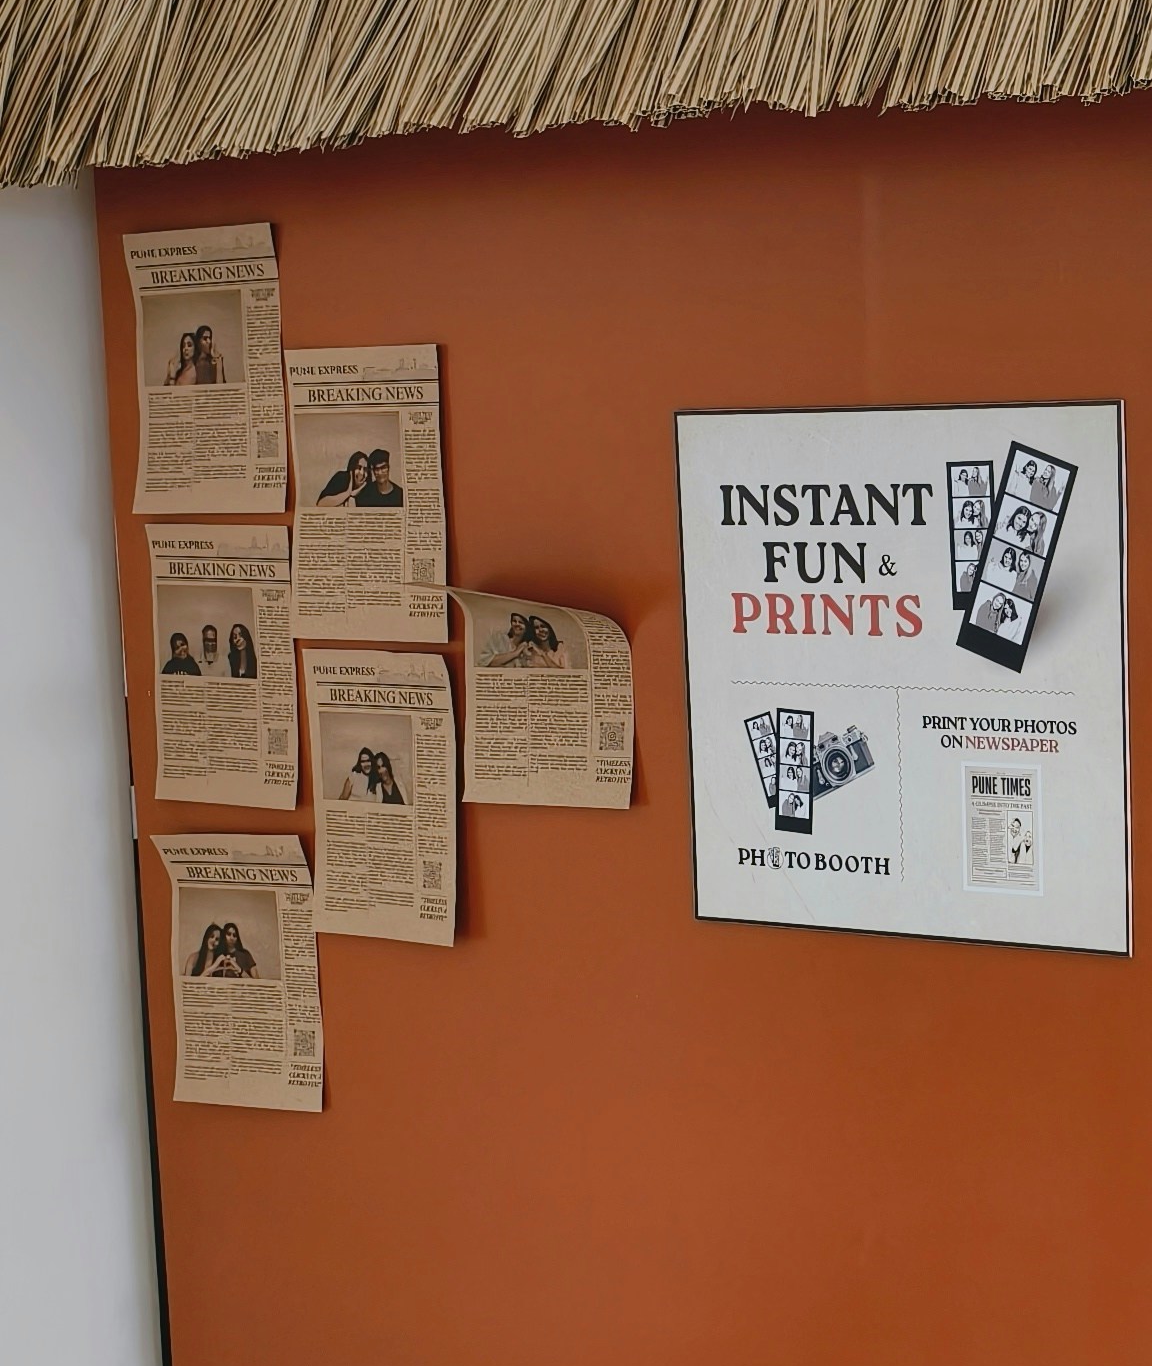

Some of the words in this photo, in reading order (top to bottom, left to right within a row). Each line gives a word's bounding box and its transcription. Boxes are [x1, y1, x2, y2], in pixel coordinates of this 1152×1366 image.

[130, 249, 157, 259] PUNE
[158, 246, 198, 258] EXPRESS
[150, 266, 223, 284] BREAKING
[225, 263, 265, 279] NEWS
[289, 366, 315, 377] PUNE
[318, 364, 359, 375] EXPRESS
[308, 387, 382, 402] BREAKING
[385, 386, 424, 401] NEWS
[719, 483, 933, 527] INSTANT
[152, 540, 176, 549] PUNE
[178, 540, 214, 550] EXPRESS
[169, 561, 236, 577] BREAKING
[238, 564, 276, 578] NEWS
[762, 541, 867, 583] FUN
[878, 554, 897, 577] &
[730, 592, 923, 638] PRINTS
[313, 665, 337, 675] PUNE
[339, 666, 375, 676] EXPRESS
[330, 688, 396, 704] BREAKING
[398, 691, 434, 706] NEWS
[922, 715, 967, 731] PRINT
[970, 717, 1012, 733] YOUR
[1014, 719, 1077, 735] PHOTOS
[941, 734, 963, 749] ON
[965, 735, 1059, 753] NEWSPAPER
[971, 775, 998, 795] PUNE
[1000, 777, 1031, 797] TIMES
[190, 847, 229, 856] EXPRESS
[814, 852, 890, 875] BOOTH
[186, 866, 257, 880] BREAKING
[257, 868, 298, 882] NEWS
